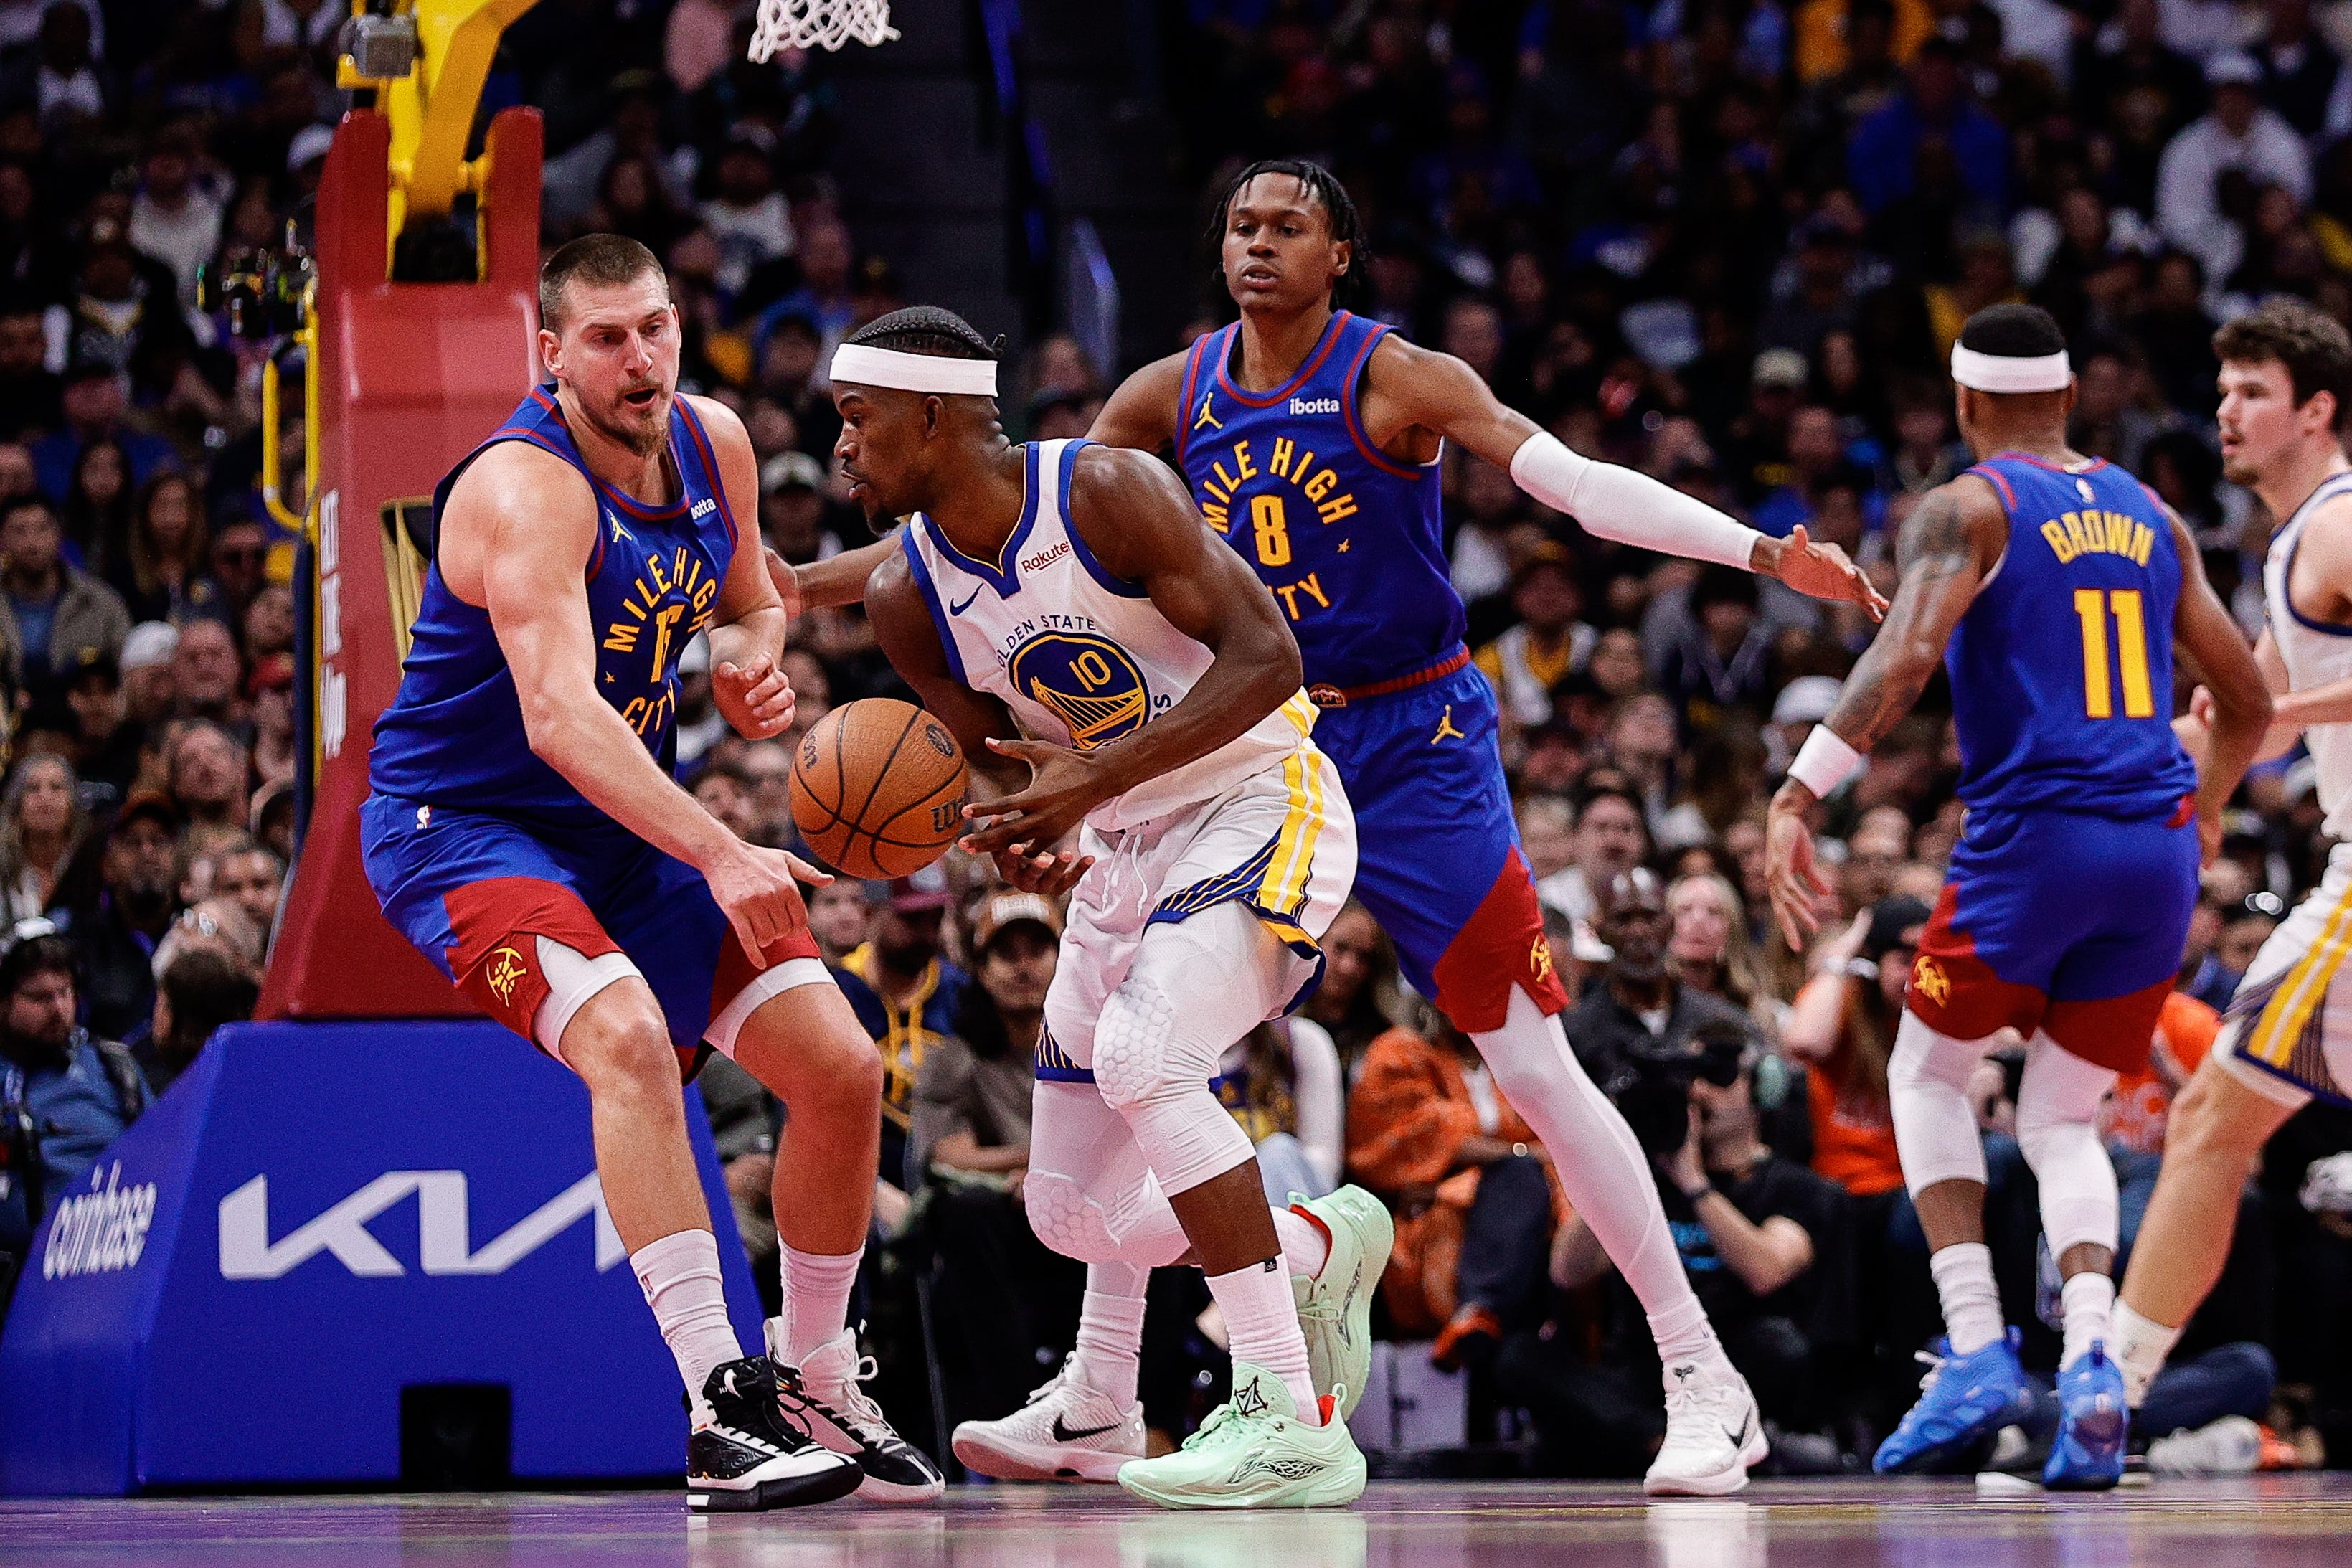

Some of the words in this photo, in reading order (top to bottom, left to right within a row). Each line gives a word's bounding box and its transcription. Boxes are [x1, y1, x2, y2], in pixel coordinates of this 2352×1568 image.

[1290, 397, 1340, 415] ibotta
[1201, 440, 1258, 534] MILE
[1270, 437, 1359, 524] HIGH
[1250, 495, 1292, 567] 8
[2040, 509, 2155, 567] BROWN
[603, 554, 672, 652] MILE
[1267, 572, 1330, 621] TY
[998, 619, 1035, 668] OLDEN
[1041, 615, 1096, 630] STATE
[2074, 589, 2155, 718] 11
[1069, 651, 1113, 694] 10
